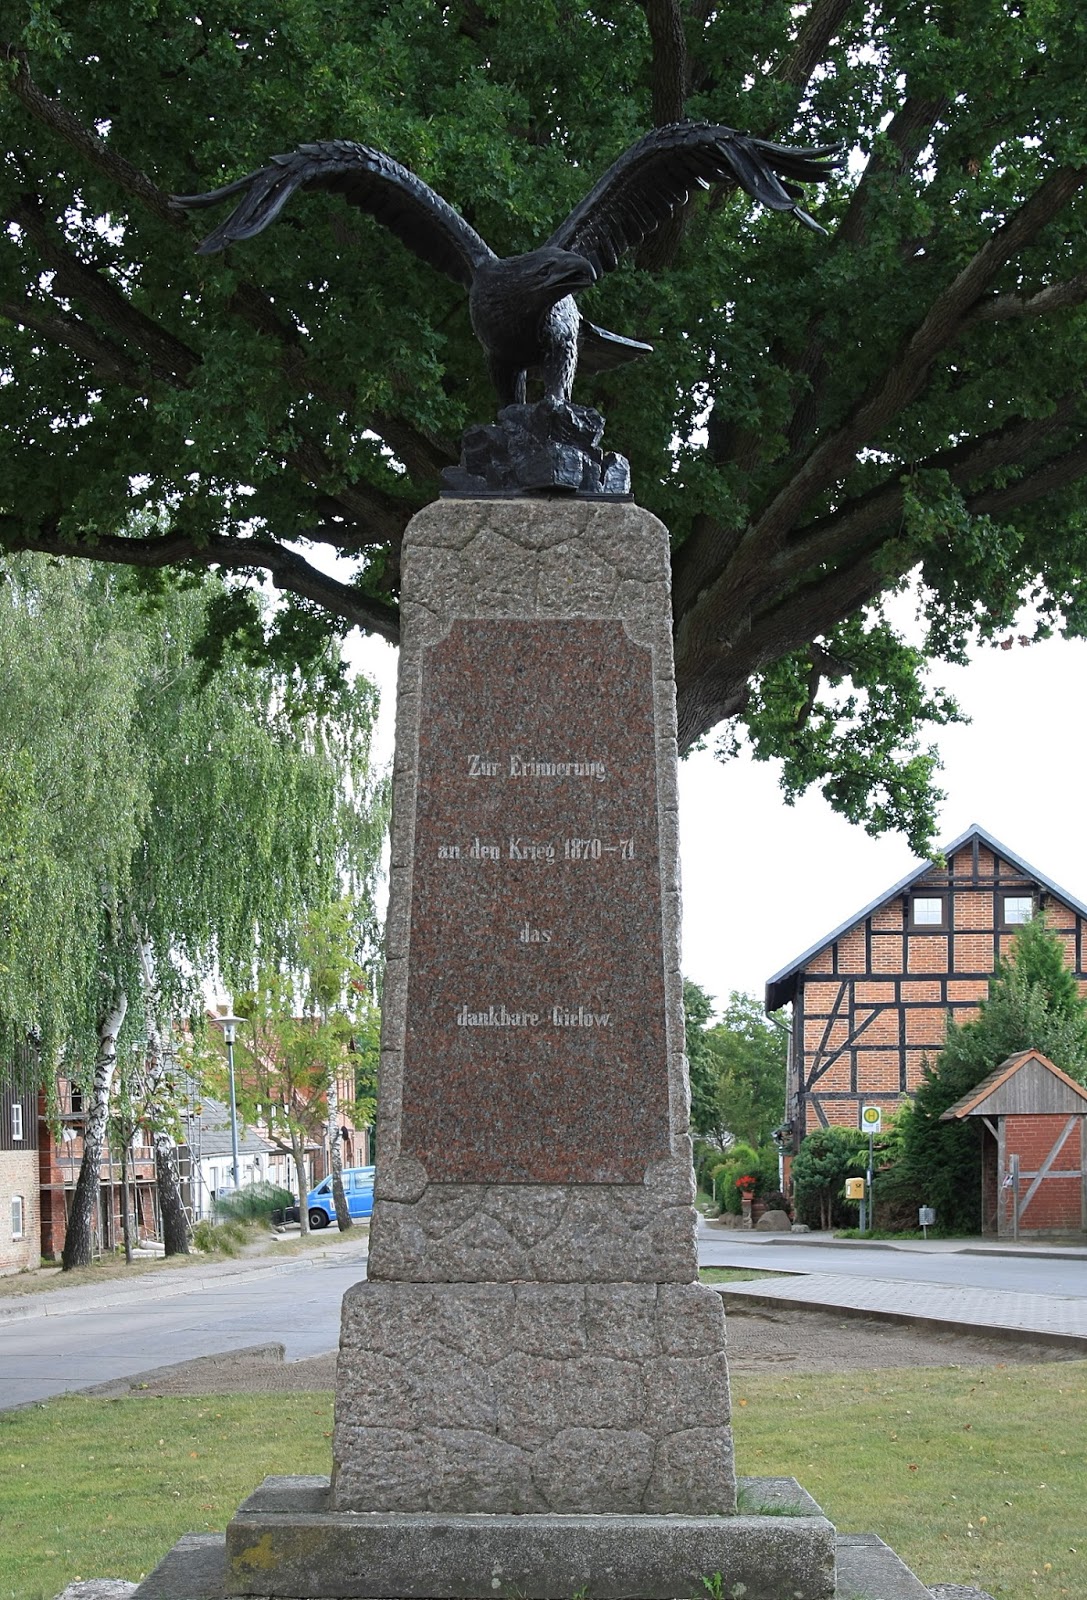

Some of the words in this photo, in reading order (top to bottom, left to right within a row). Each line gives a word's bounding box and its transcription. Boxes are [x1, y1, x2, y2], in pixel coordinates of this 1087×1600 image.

[467, 754, 501, 777] Zur
[509, 755, 606, 782] Erinnerung
[437, 844, 460, 860] an
[469, 838, 500, 860] den
[508, 837, 555, 865] Krieg
[519, 921, 552, 943] das
[456, 1004, 540, 1027] dankbare
